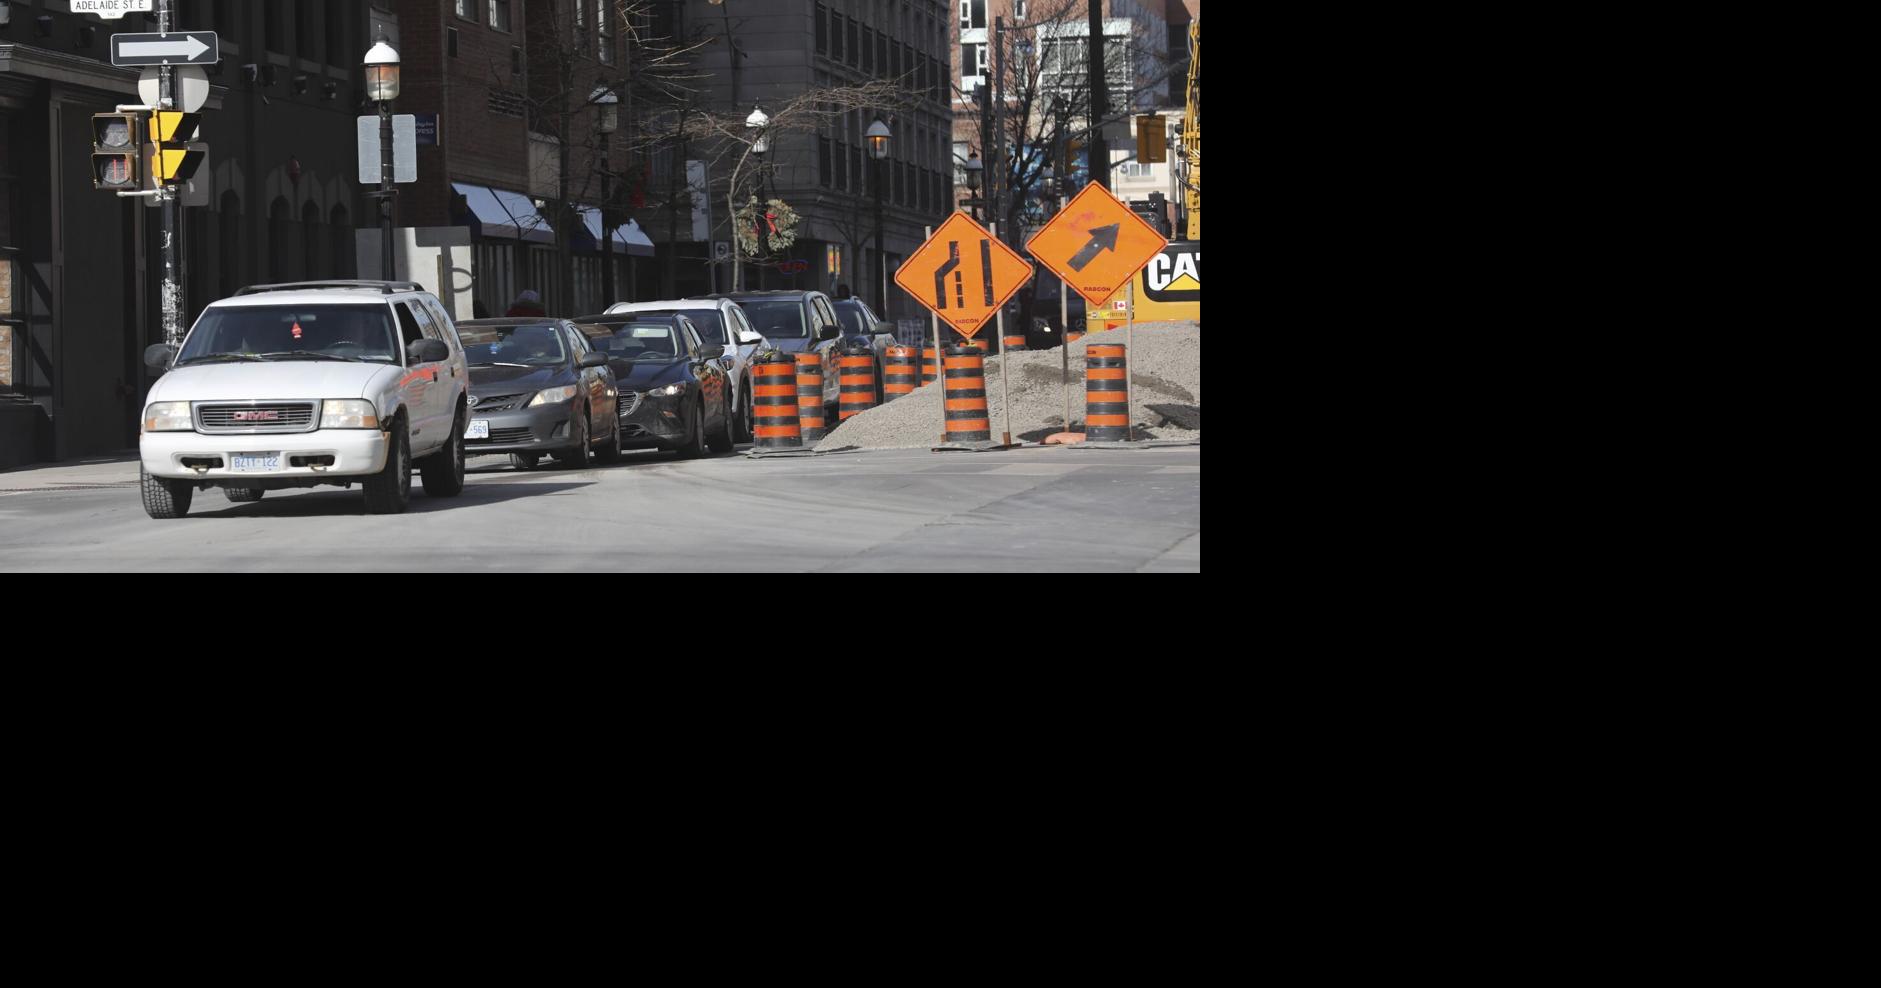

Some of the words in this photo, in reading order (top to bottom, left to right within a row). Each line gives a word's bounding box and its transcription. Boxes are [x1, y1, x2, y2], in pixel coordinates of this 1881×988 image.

[76, 0, 119, 10] ADELAIDE
[123, 0, 133, 9] ST
[138, 0, 144, 9] E
[1147, 252, 1200, 291] CA
[233, 410, 278, 420] GMC
